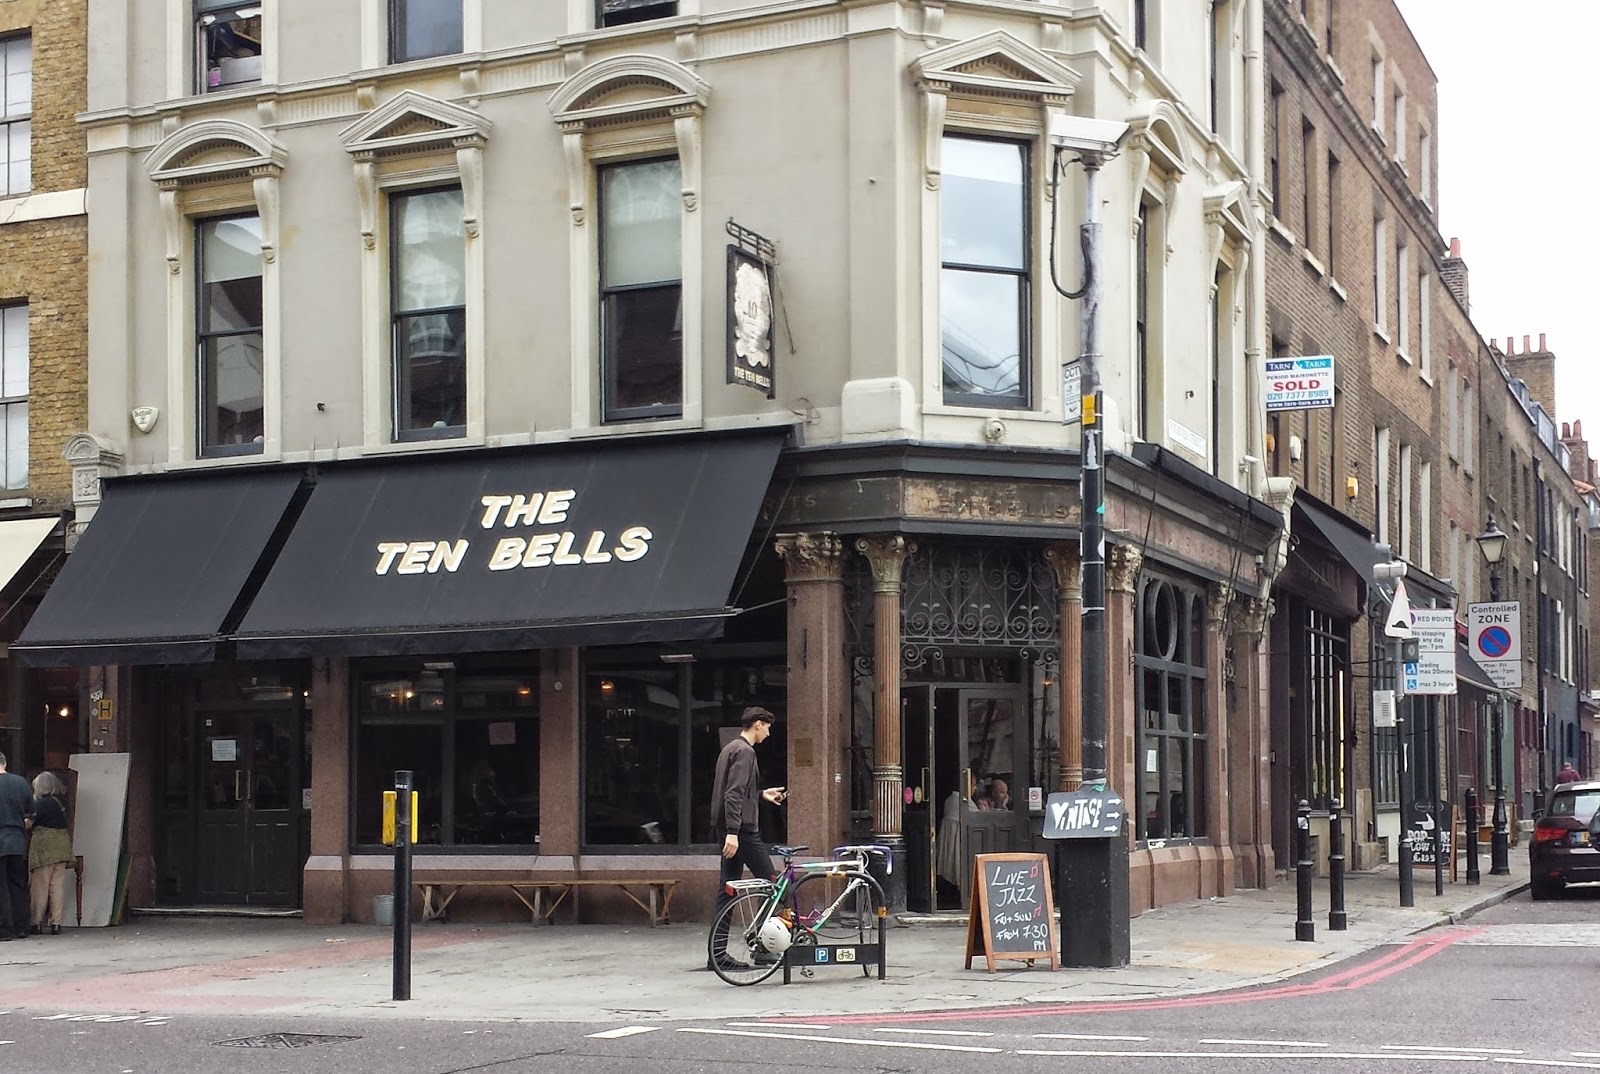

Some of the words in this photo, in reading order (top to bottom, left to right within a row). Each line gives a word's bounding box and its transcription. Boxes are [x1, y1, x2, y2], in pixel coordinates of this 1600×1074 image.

[1305, 360, 1326, 368] TARN
[1064, 366, 1080, 379] CCT
[1273, 380, 1320, 392] SOLD
[1286, 391, 1305, 399] 7377
[480, 488, 577, 529] THE
[375, 538, 470, 576] TEN
[488, 526, 653, 572] BELLS
[1471, 605, 1517, 613] Controlled
[1478, 614, 1510, 623] ZONE
[100, 701, 111, 718] H
[991, 866, 1028, 885] LIVE
[995, 884, 1037, 907] JAZZ
[996, 928, 1019, 940] FROM
[1033, 939, 1047, 952] PM
